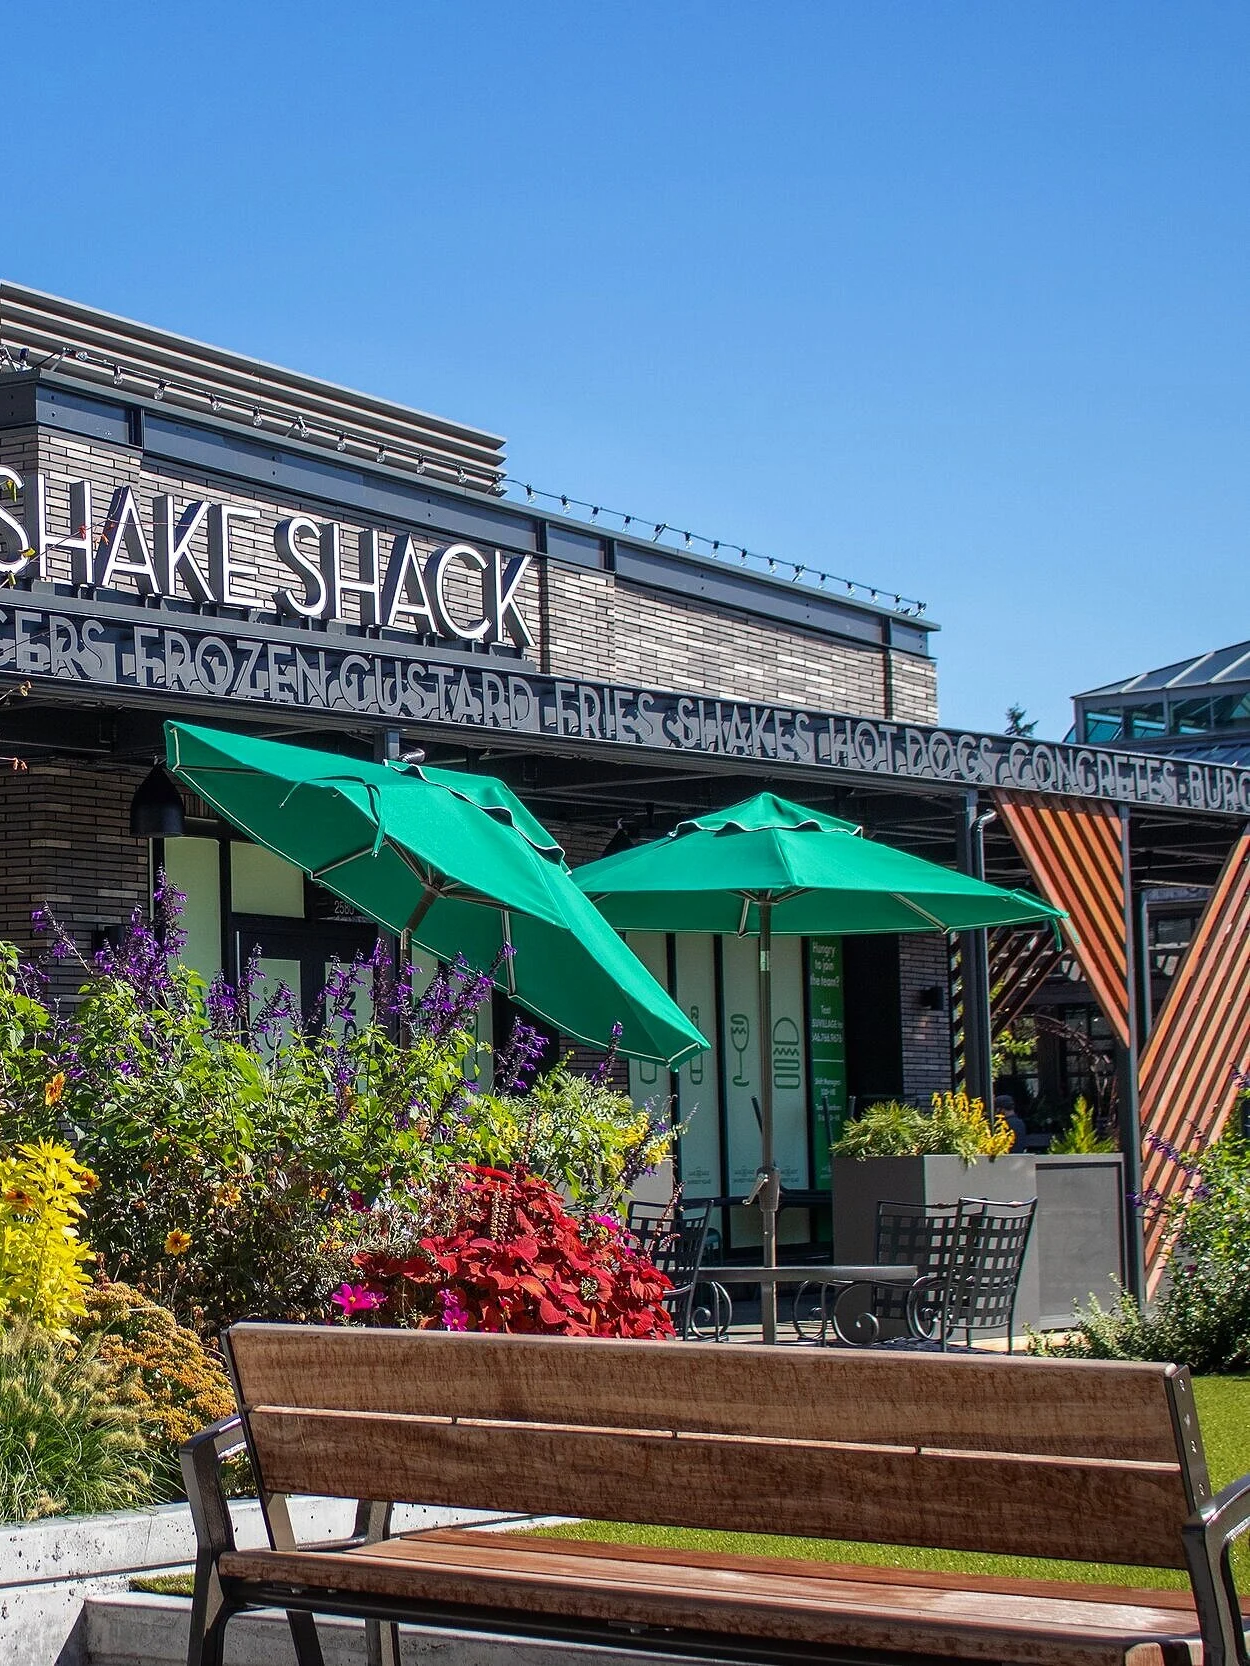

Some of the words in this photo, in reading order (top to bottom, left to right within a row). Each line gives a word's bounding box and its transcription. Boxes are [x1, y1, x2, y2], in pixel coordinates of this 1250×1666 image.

[274, 516, 537, 649] SHACK
[133, 625, 328, 708] FROZEN
[338, 654, 534, 730] CUSTARD
[554, 681, 655, 744] FRIES
[677, 697, 811, 763] SHAKES
[828, 717, 898, 773] HOT
[905, 727, 994, 784] DOGS
[1007, 741, 1176, 804] CONCRETES
